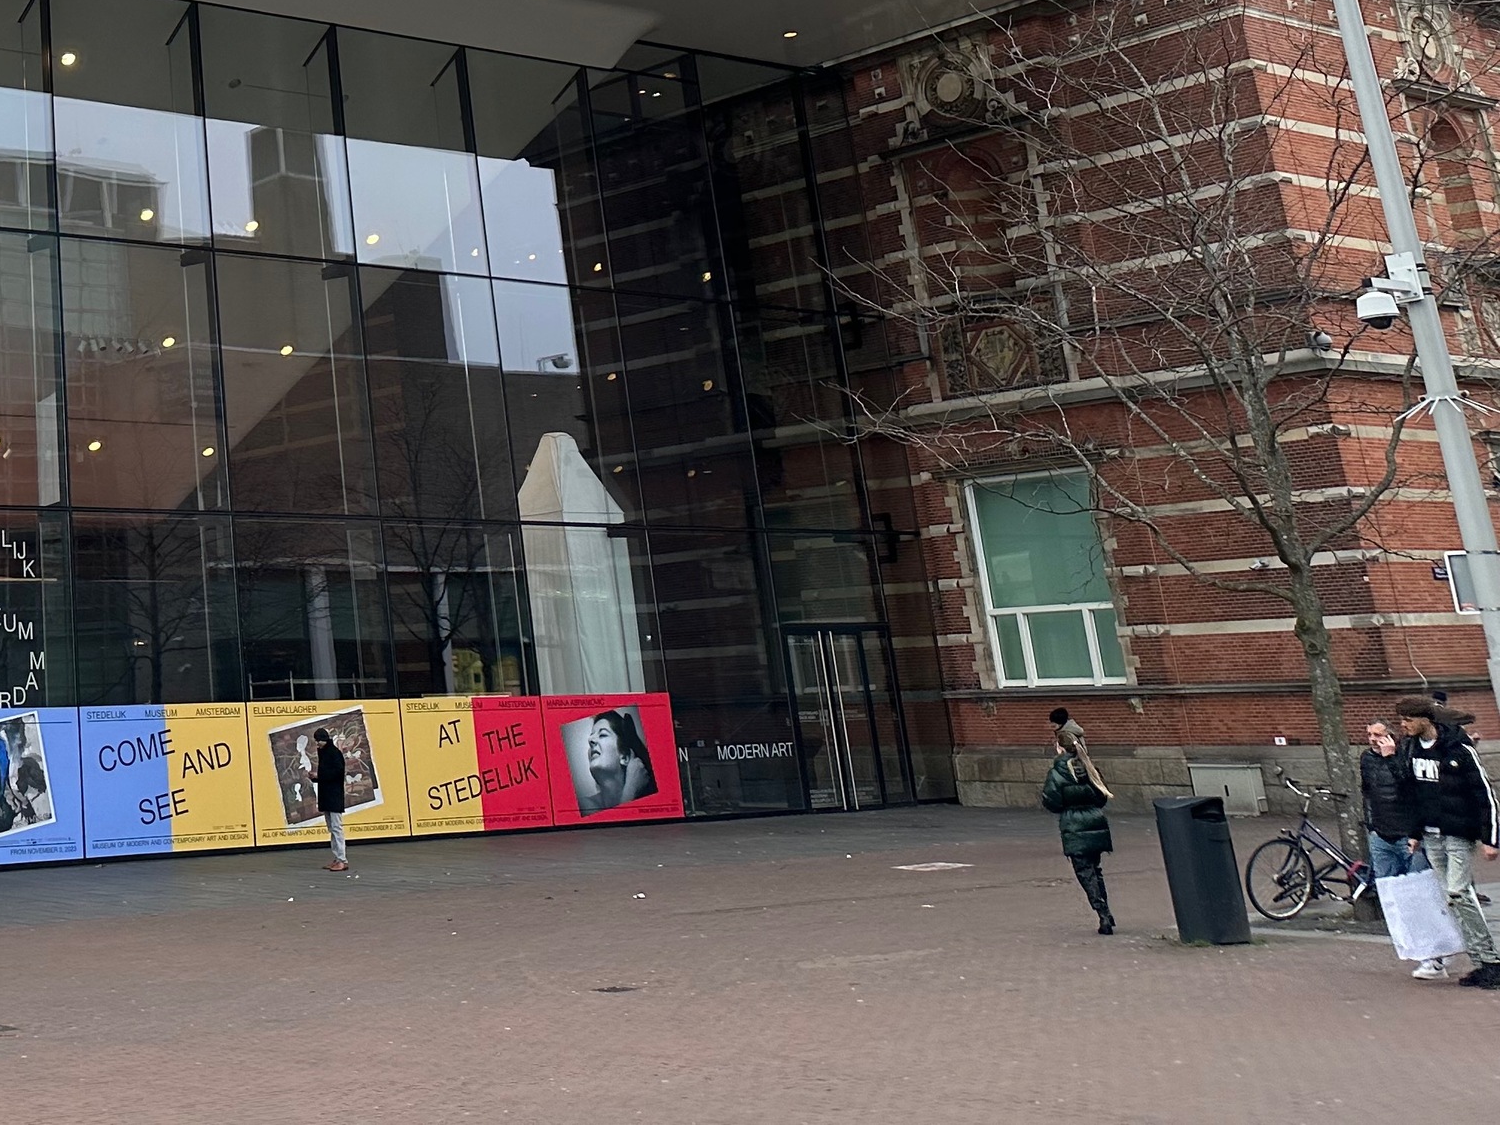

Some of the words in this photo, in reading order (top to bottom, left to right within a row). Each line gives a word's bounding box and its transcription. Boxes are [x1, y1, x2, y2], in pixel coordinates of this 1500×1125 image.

[86, 710, 127, 719] STEDELIJK
[144, 709, 178, 718] MUSEUM
[195, 707, 241, 716] AMSTERDAM
[253, 707, 275, 715] ELLEN
[276, 705, 317, 714] GALLAGHER
[406, 702, 440, 711] STEDELIJK
[454, 701, 483, 709] MUSEUM
[498, 700, 536, 708] AMSTERDAM
[439, 719, 461, 748] AT
[482, 723, 526, 754] THE
[98, 729, 176, 772] COME
[182, 742, 232, 779] AND
[717, 743, 769, 760] MODERN
[771, 742, 793, 758] ART
[427, 756, 539, 811] STEDELIJK
[138, 788, 189, 825] SEE
[92, 842, 116, 850] MUSEUM
[163, 836, 206, 845] CONTEMPORARY
